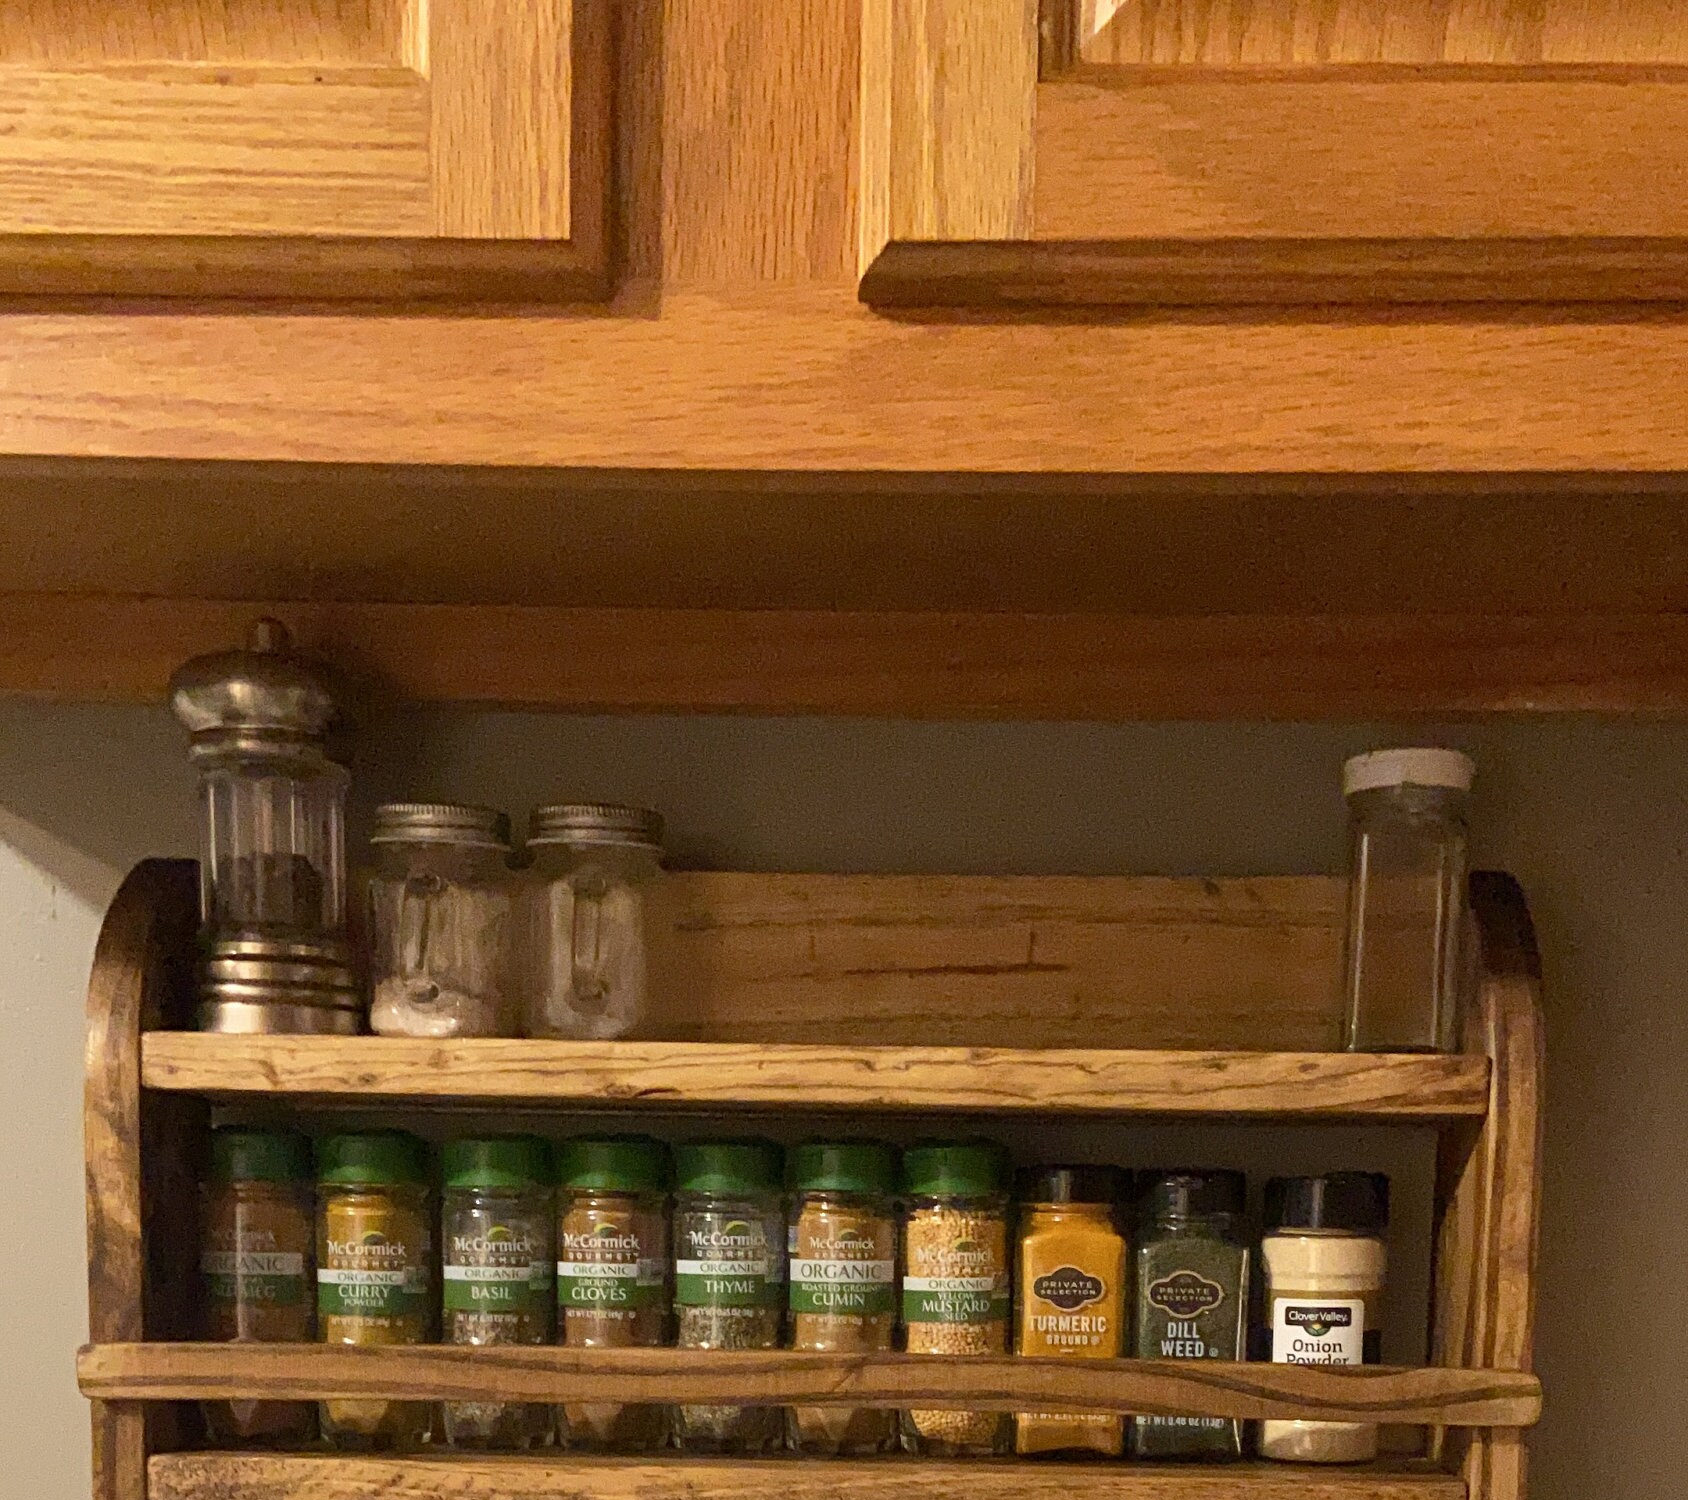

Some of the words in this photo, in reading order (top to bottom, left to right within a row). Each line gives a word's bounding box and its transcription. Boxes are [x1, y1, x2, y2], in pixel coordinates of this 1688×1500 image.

[454, 1236, 533, 1253] McCormick
[563, 1232, 641, 1249] McCormick
[689, 1230, 768, 1247] McCormick
[809, 1237, 875, 1250] McCormick
[327, 1240, 407, 1257] McCormick
[917, 1247, 995, 1263] McCormick
[568, 1252, 632, 1261] GOURMET
[464, 1268, 520, 1279] ORGANIC
[572, 1265, 629, 1275] ORGANIC
[699, 1262, 760, 1273] ORGANIC
[800, 1263, 882, 1279] ORGANIC
[337, 1272, 395, 1283] ORGANIC
[578, 1279, 618, 1287] GROUND
[338, 1285, 390, 1298] CURRY
[704, 1280, 756, 1294] THYME
[801, 1283, 840, 1292] ROASTED
[928, 1280, 988, 1290] ORGANIC
[1042, 1281, 1093, 1289] PRIVATE
[1159, 1287, 1210, 1295] PRIVATE
[471, 1286, 513, 1300] BASIL
[571, 1287, 627, 1301] CLOVES
[812, 1293, 865, 1306] CUMIN
[937, 1292, 975, 1300] YELLOW
[344, 1298, 384, 1308] POWDER
[921, 1300, 990, 1313] MUSTARD
[1288, 1310, 1320, 1321] Clover
[1028, 1315, 1107, 1332] TURMERIC
[1167, 1321, 1200, 1339] DILL
[1046, 1334, 1088, 1345] GROUND
[1292, 1339, 1343, 1353] Onion
[1161, 1340, 1204, 1358] WEED
[1286, 1353, 1350, 1365] Powder
